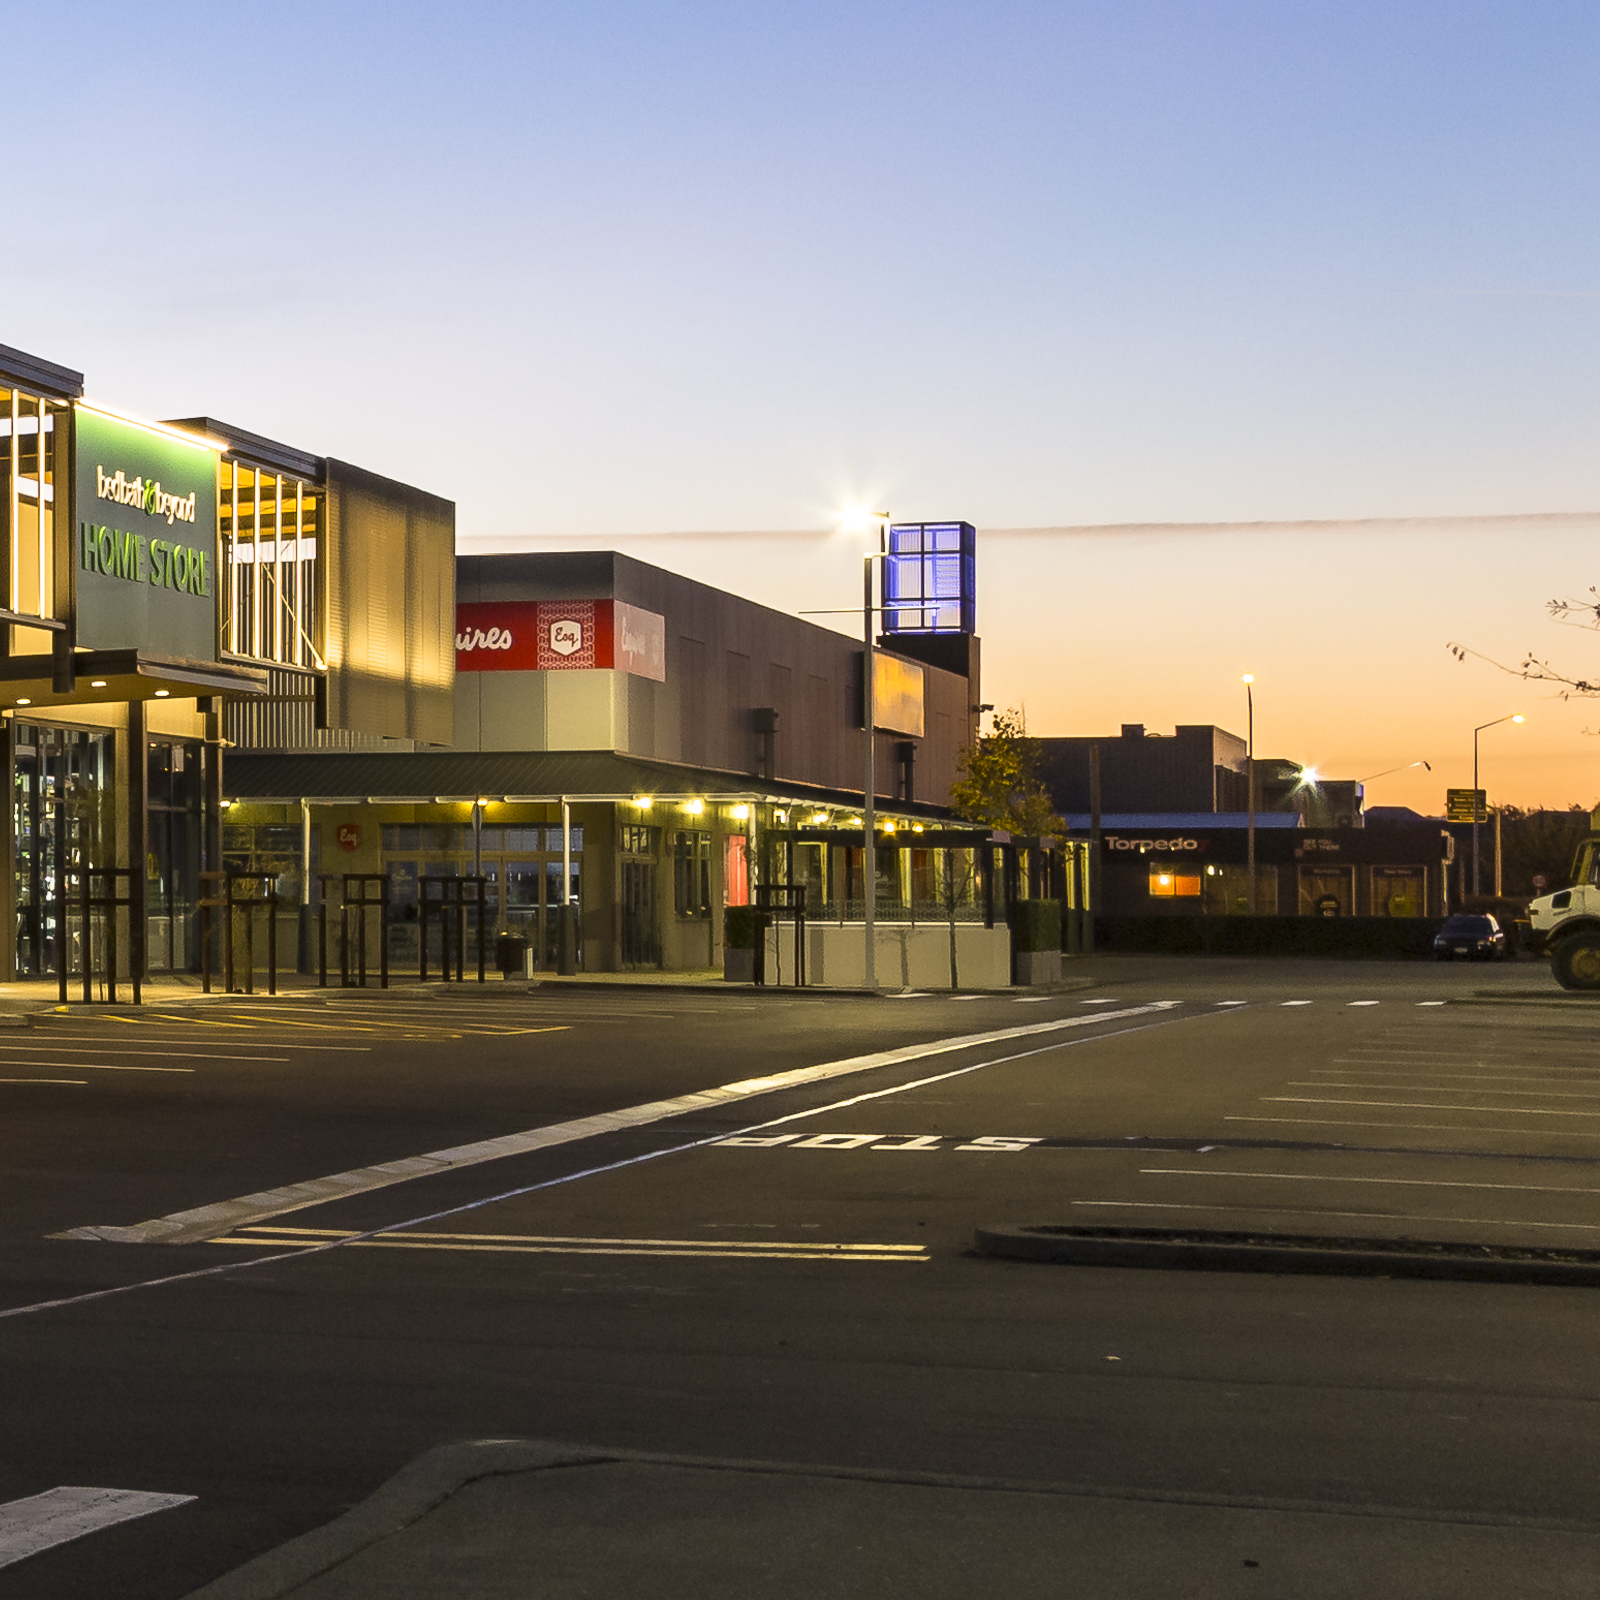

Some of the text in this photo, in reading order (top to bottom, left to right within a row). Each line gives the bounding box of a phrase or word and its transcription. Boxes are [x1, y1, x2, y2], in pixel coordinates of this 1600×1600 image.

[96, 464, 196, 525] bedbath&beyond
[81, 521, 211, 598] HOME STORE
[554, 627, 579, 648] Esq
[340, 828, 358, 847] Esq
